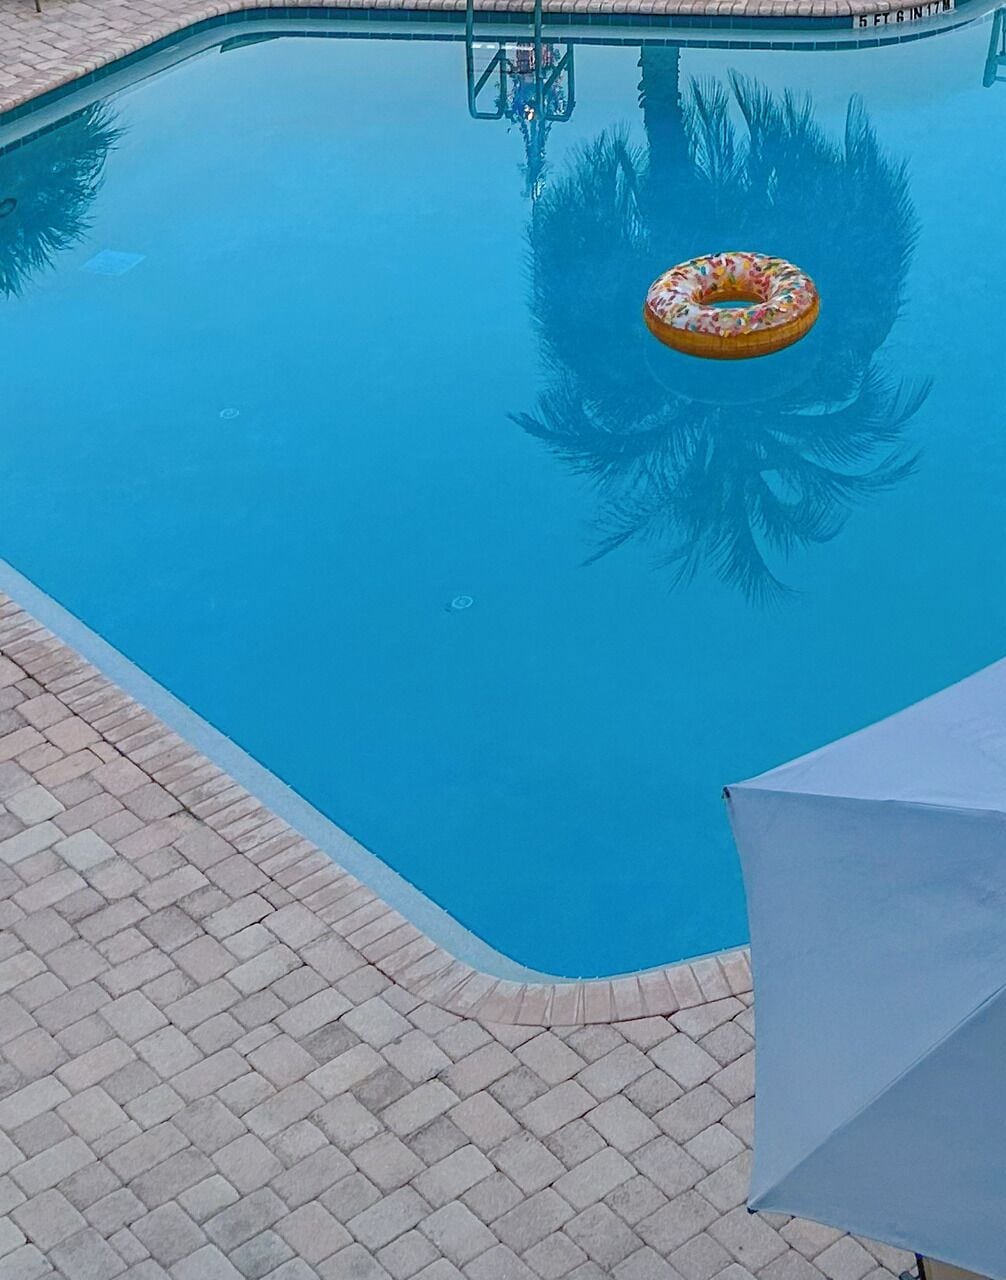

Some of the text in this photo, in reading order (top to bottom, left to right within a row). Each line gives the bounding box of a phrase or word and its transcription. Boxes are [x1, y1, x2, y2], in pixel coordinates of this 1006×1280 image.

[859, 14, 867, 28] 5
[873, 12, 889, 26] FT
[910, 6, 922, 20] IN
